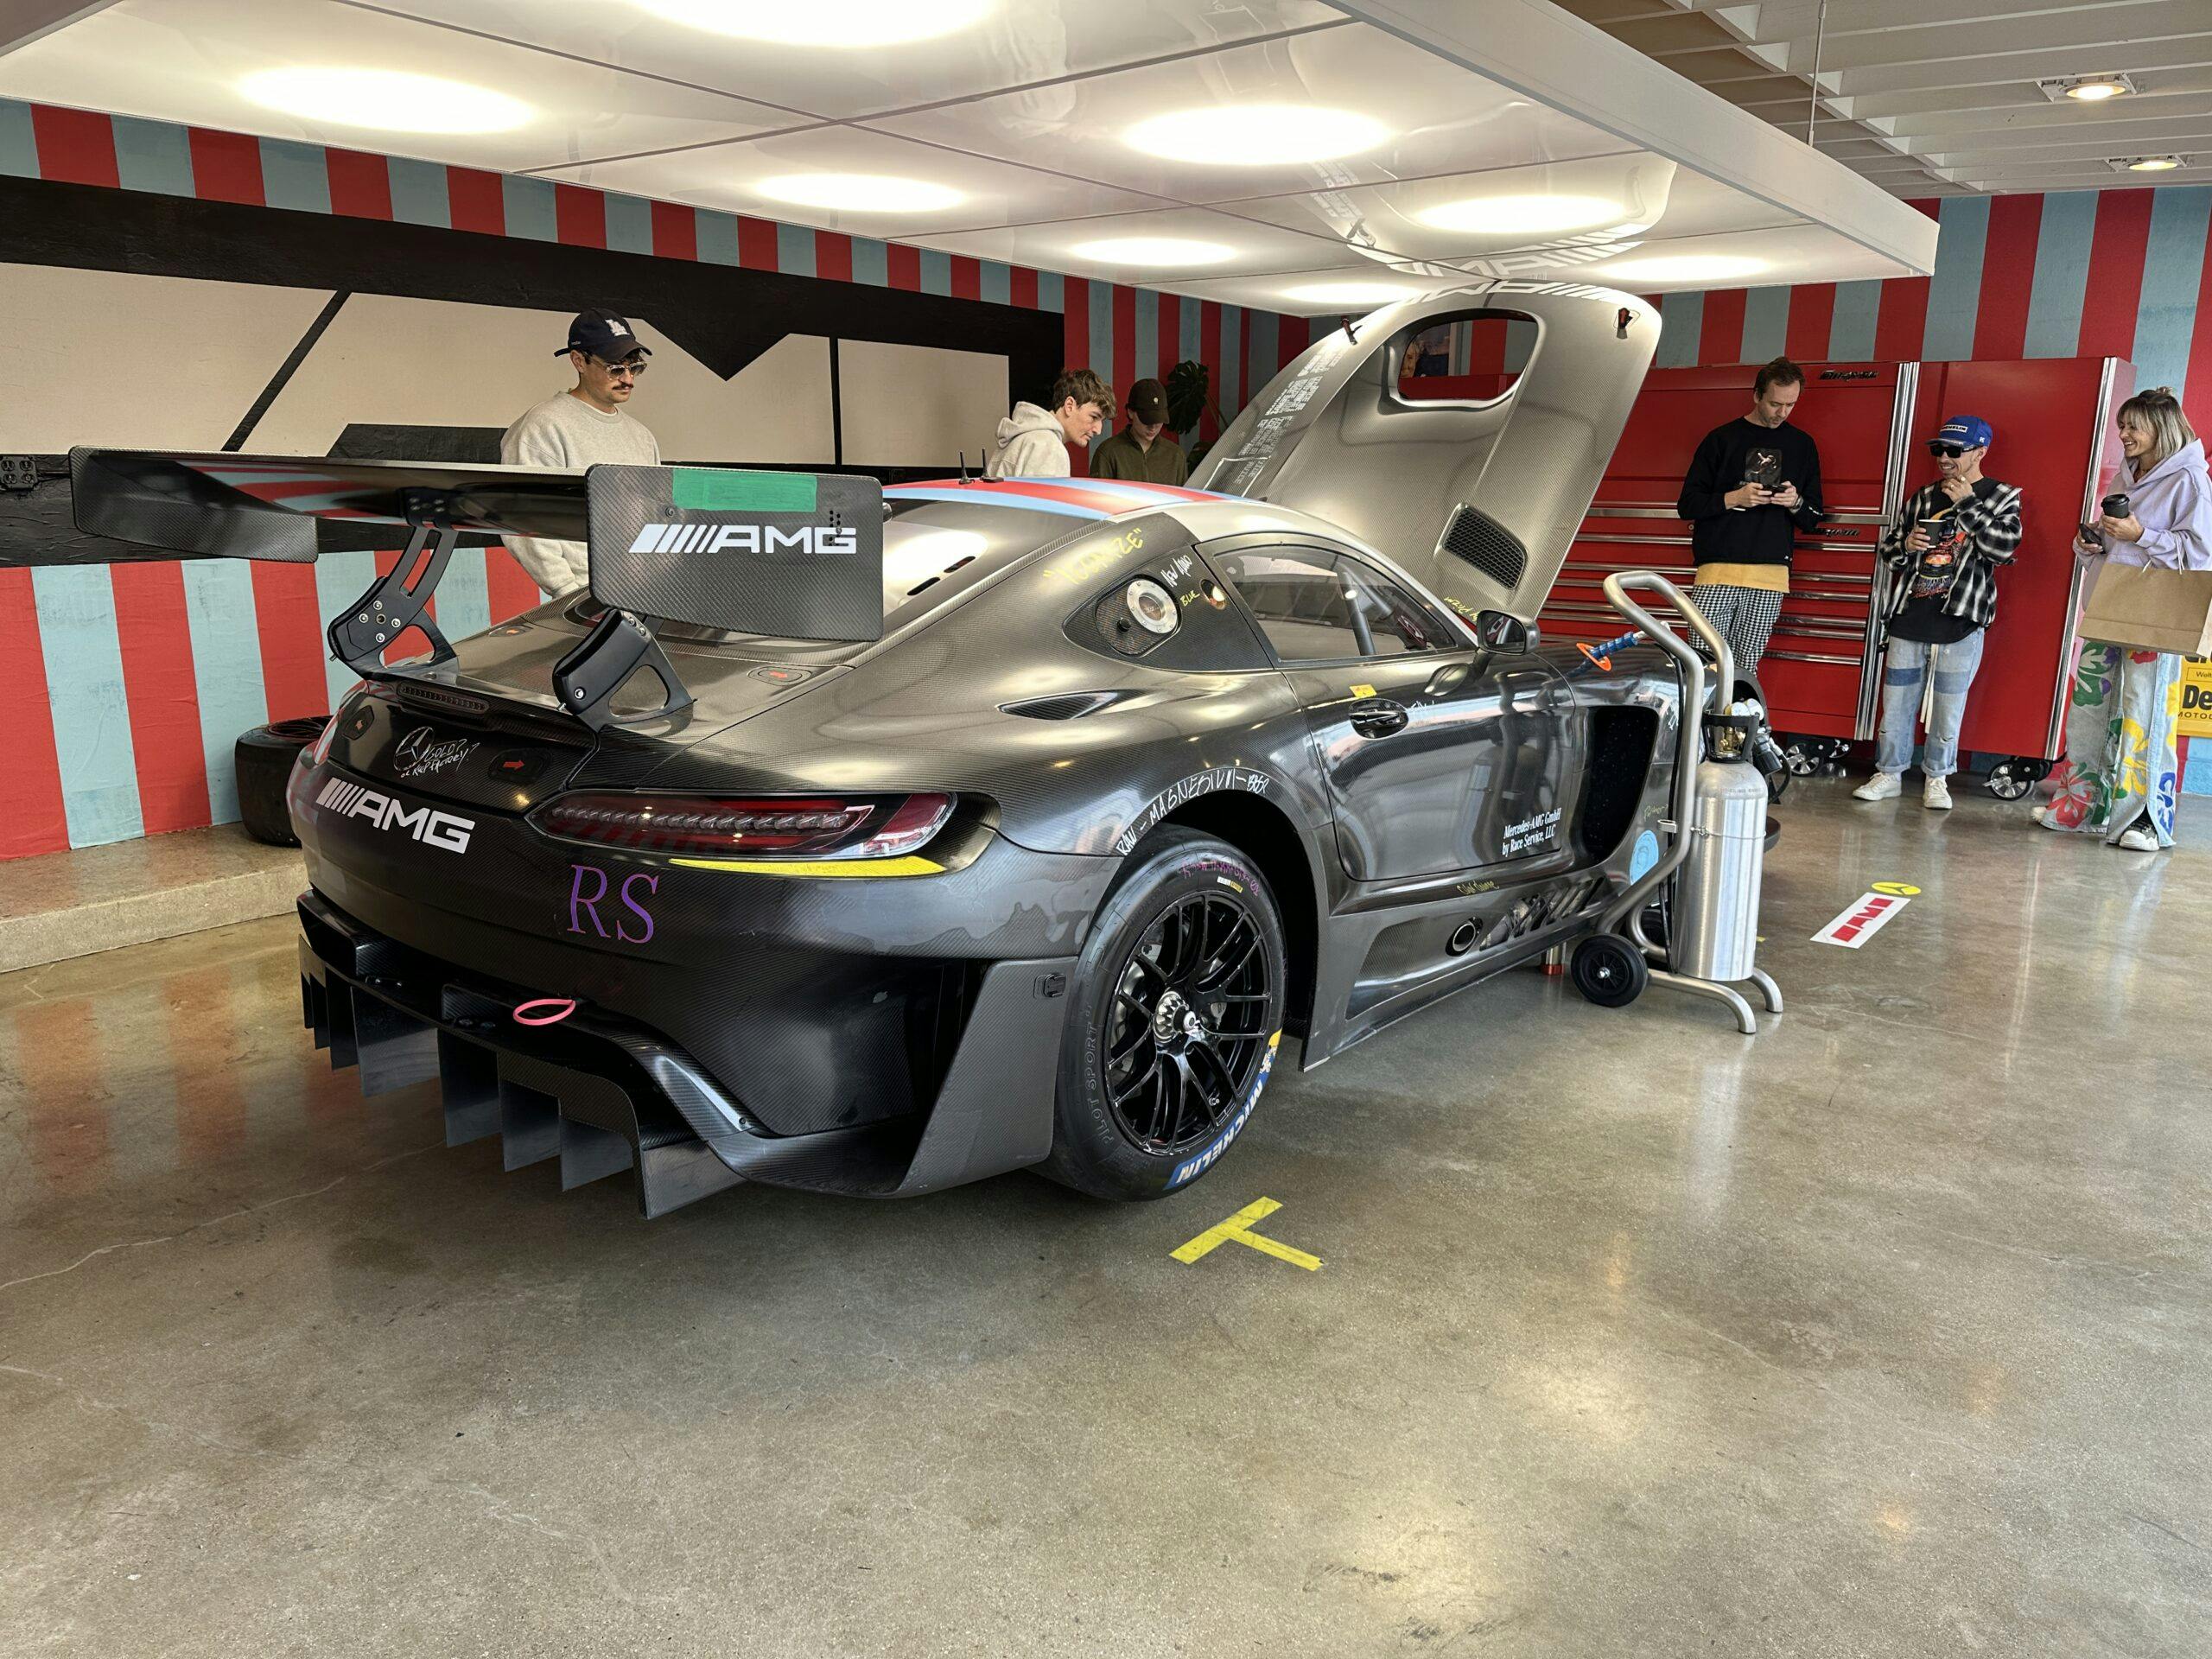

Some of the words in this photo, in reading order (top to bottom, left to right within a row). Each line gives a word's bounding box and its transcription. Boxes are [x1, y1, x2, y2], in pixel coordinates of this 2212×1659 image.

[707, 524, 857, 554] AMG
[346, 791, 476, 855] AMG
[566, 864, 660, 944] RS
[1175, 1079, 1264, 1185] MICHELIN
